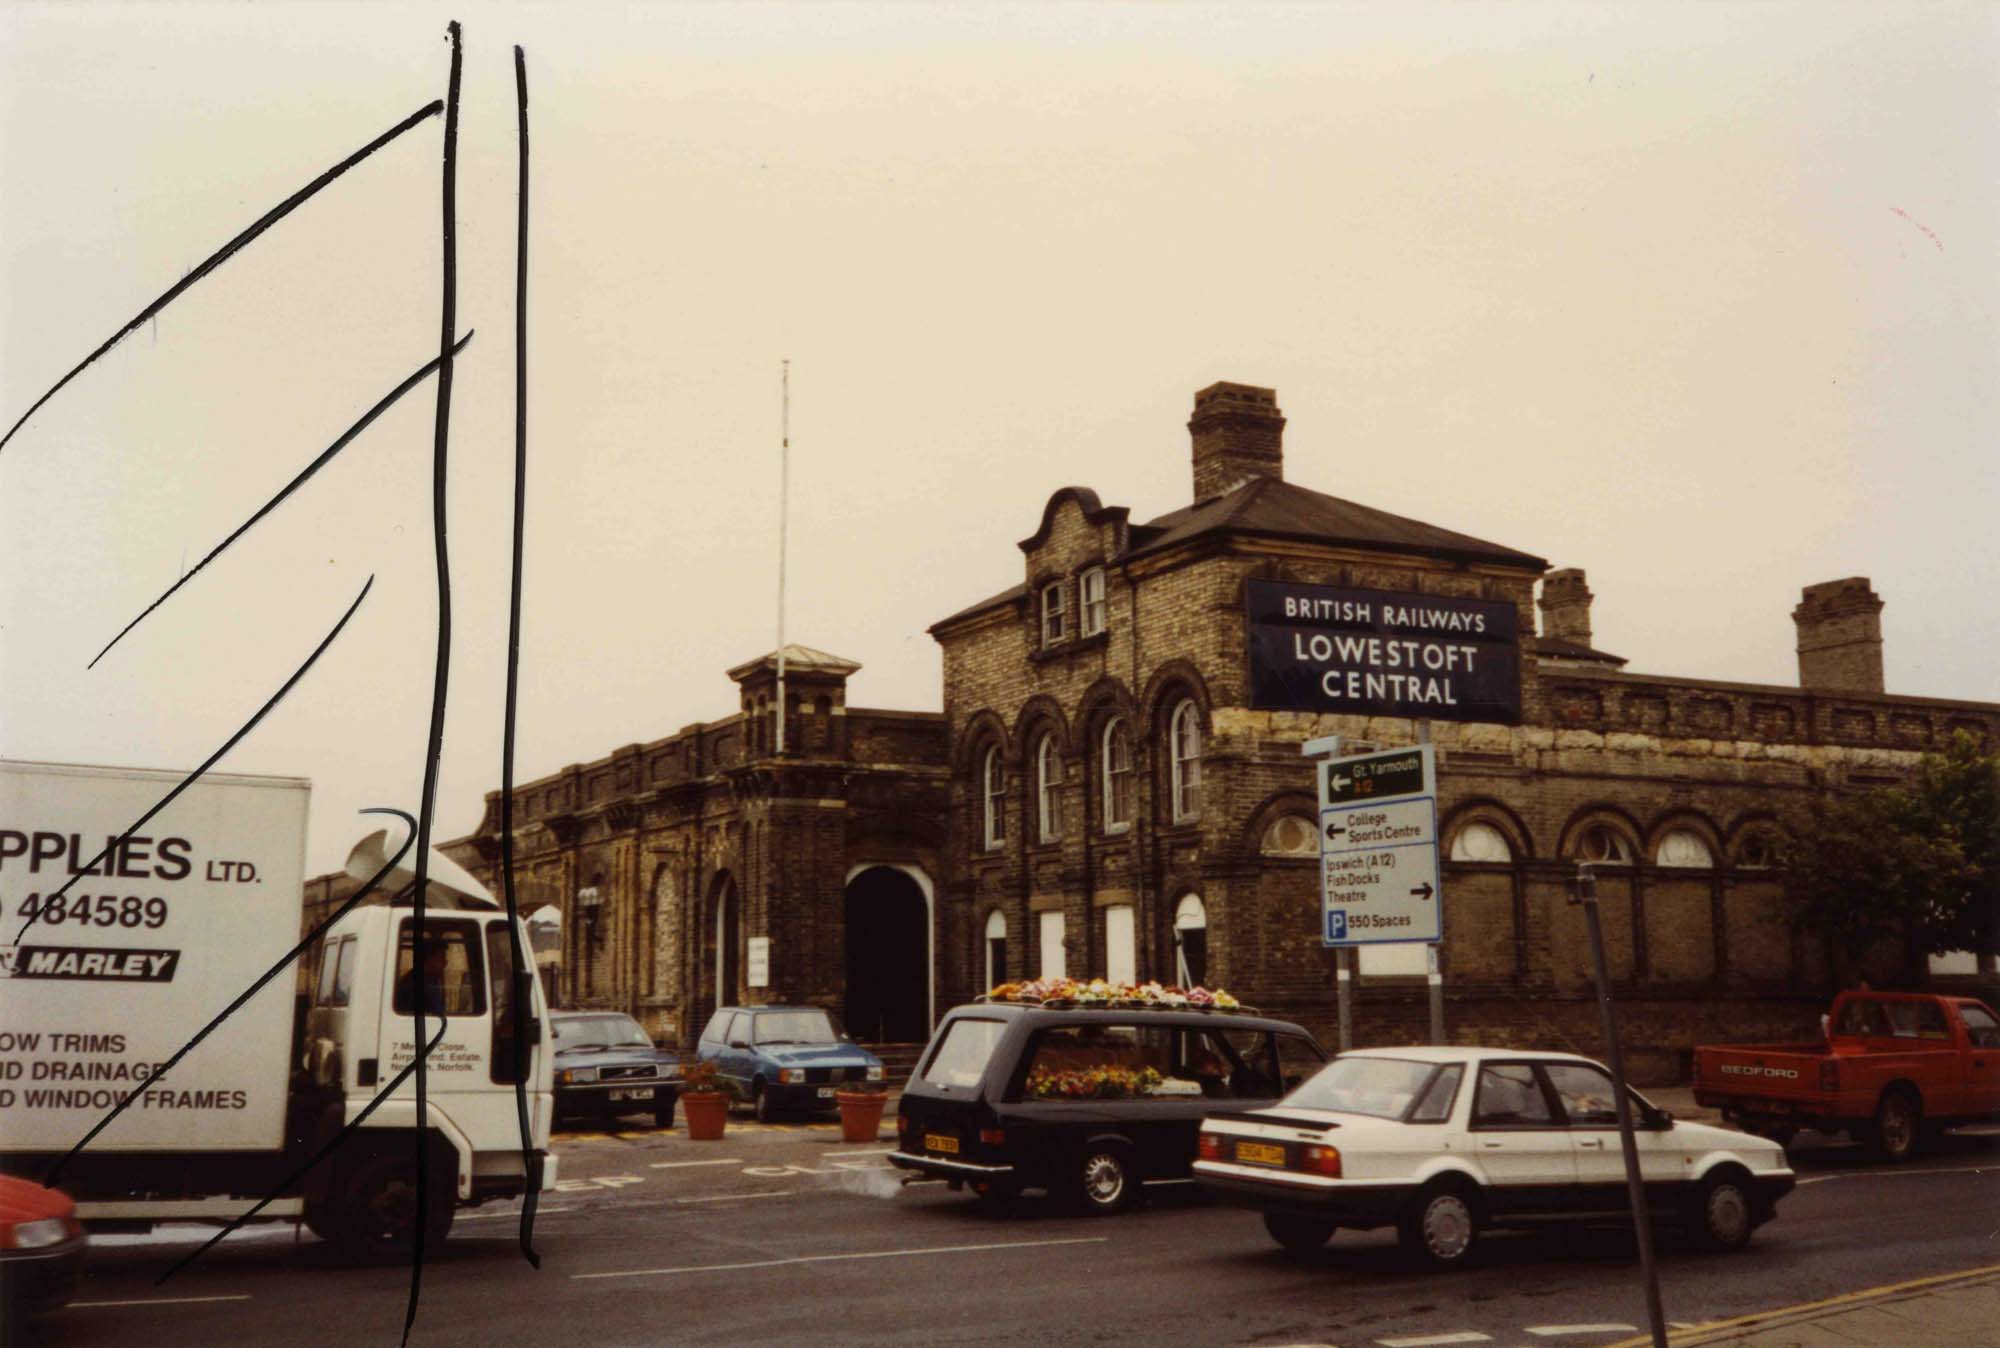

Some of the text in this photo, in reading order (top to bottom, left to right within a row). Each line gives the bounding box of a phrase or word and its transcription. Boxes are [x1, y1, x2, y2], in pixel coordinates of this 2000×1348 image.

[1285, 597, 1485, 632] BRITISH RAILWAYS
[1295, 634, 1477, 672] LOWESTOFT
[1322, 671, 1457, 705] CENTRAL
[1369, 756, 1419, 778] Yarmouth
[1347, 812, 1388, 828] College
[1348, 824, 1420, 844] Sports Centre
[206, 860, 261, 883] LTD.
[1326, 855, 1364, 872] Ipswich
[1327, 872, 1380, 887] Fish Docks
[1328, 889, 1367, 903] Theatre
[17, 892, 168, 929] 484589
[1348, 915, 1370, 929] 550
[1372, 913, 1411, 930] Spaces
[27, 950, 169, 977] MARLEY
[48, 1033, 126, 1053] TRIMS
[0, 1061, 167, 1081] D DRAINAGE
[1721, 1064, 1798, 1079] BEDFORD
[24, 1089, 134, 1109] WINDOW
[143, 1090, 247, 1109] FRAMES
